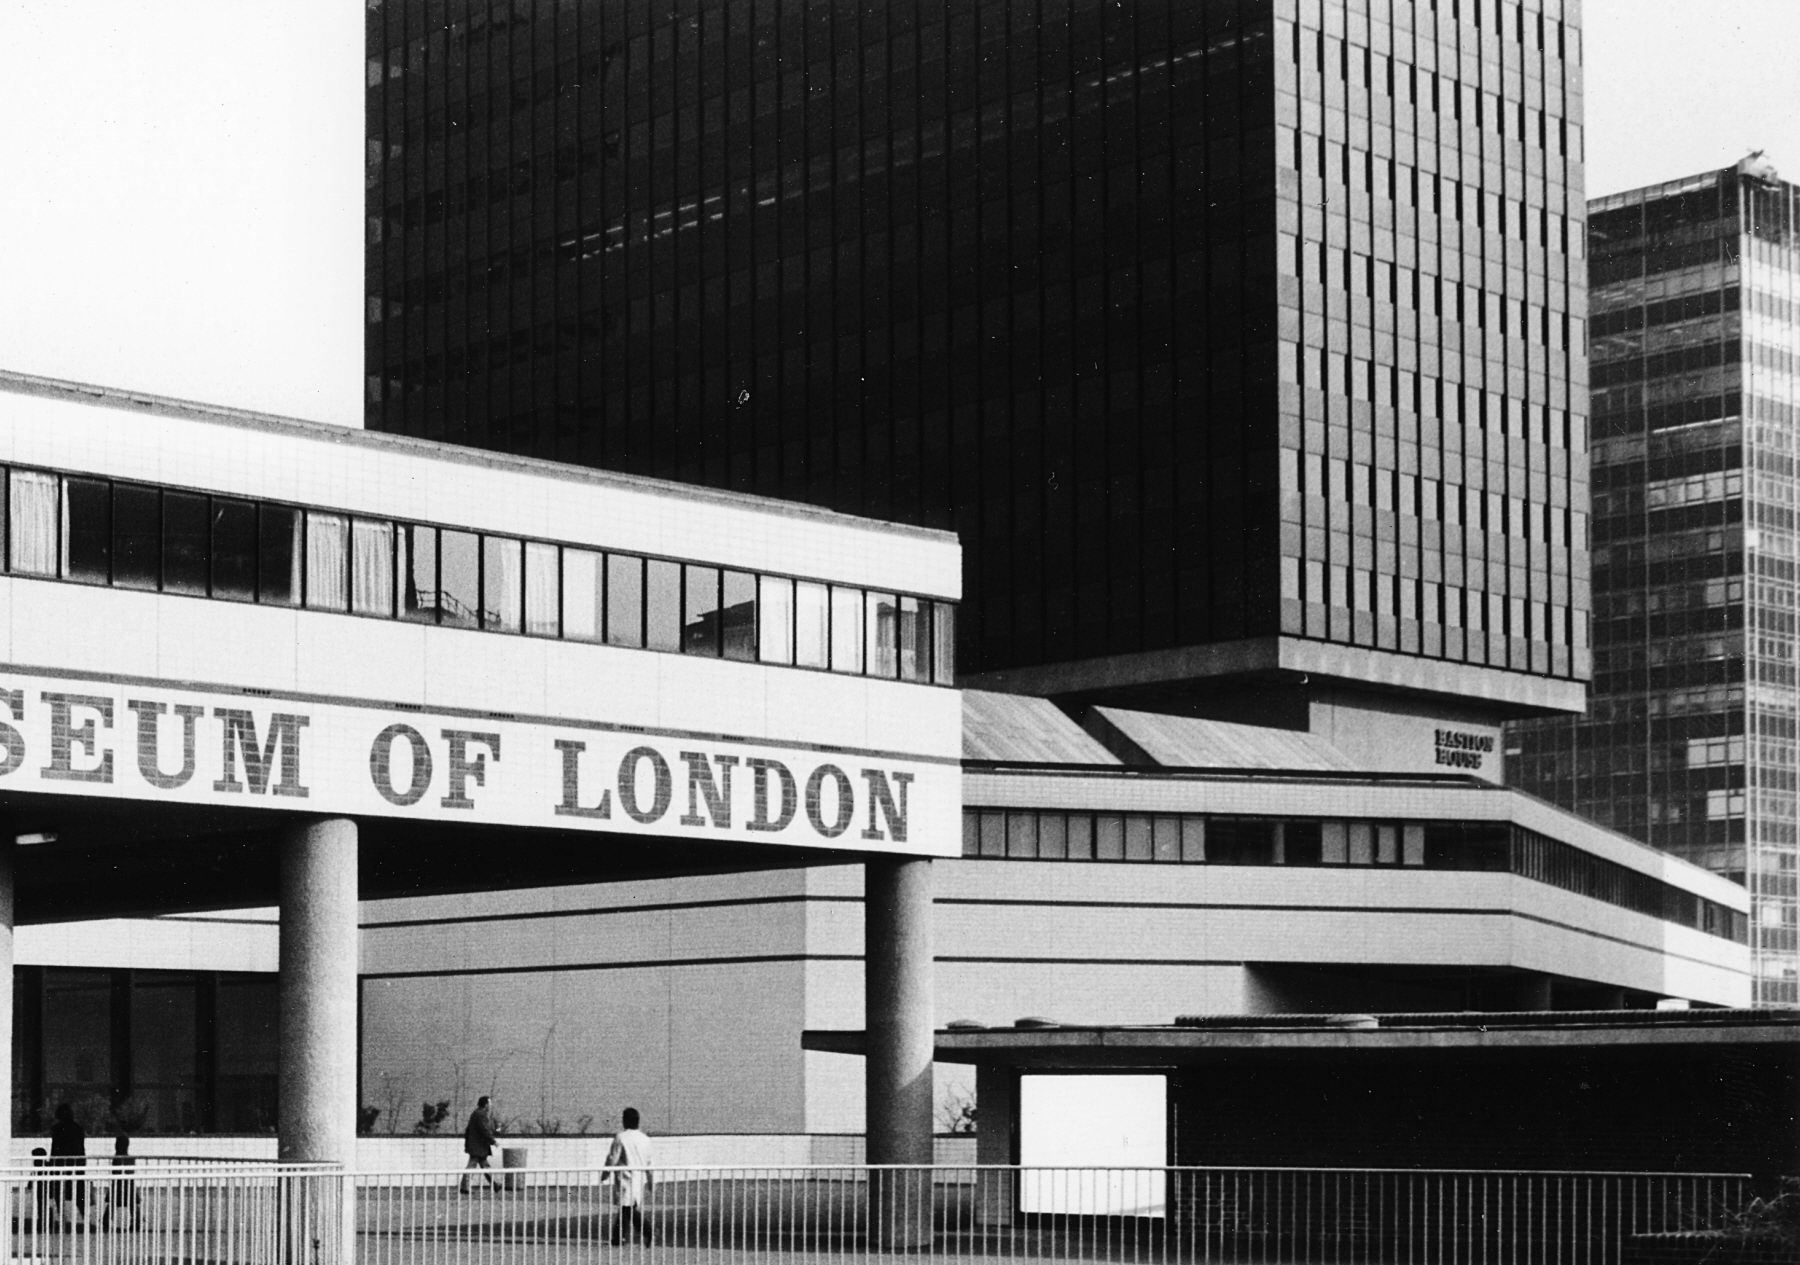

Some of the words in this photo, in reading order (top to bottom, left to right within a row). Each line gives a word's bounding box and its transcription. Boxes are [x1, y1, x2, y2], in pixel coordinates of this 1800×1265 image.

[1435, 729, 1494, 752] BASTION
[1435, 748, 1482, 769] HOUSE
[369, 723, 502, 809] OF
[554, 740, 915, 843] LONDON
